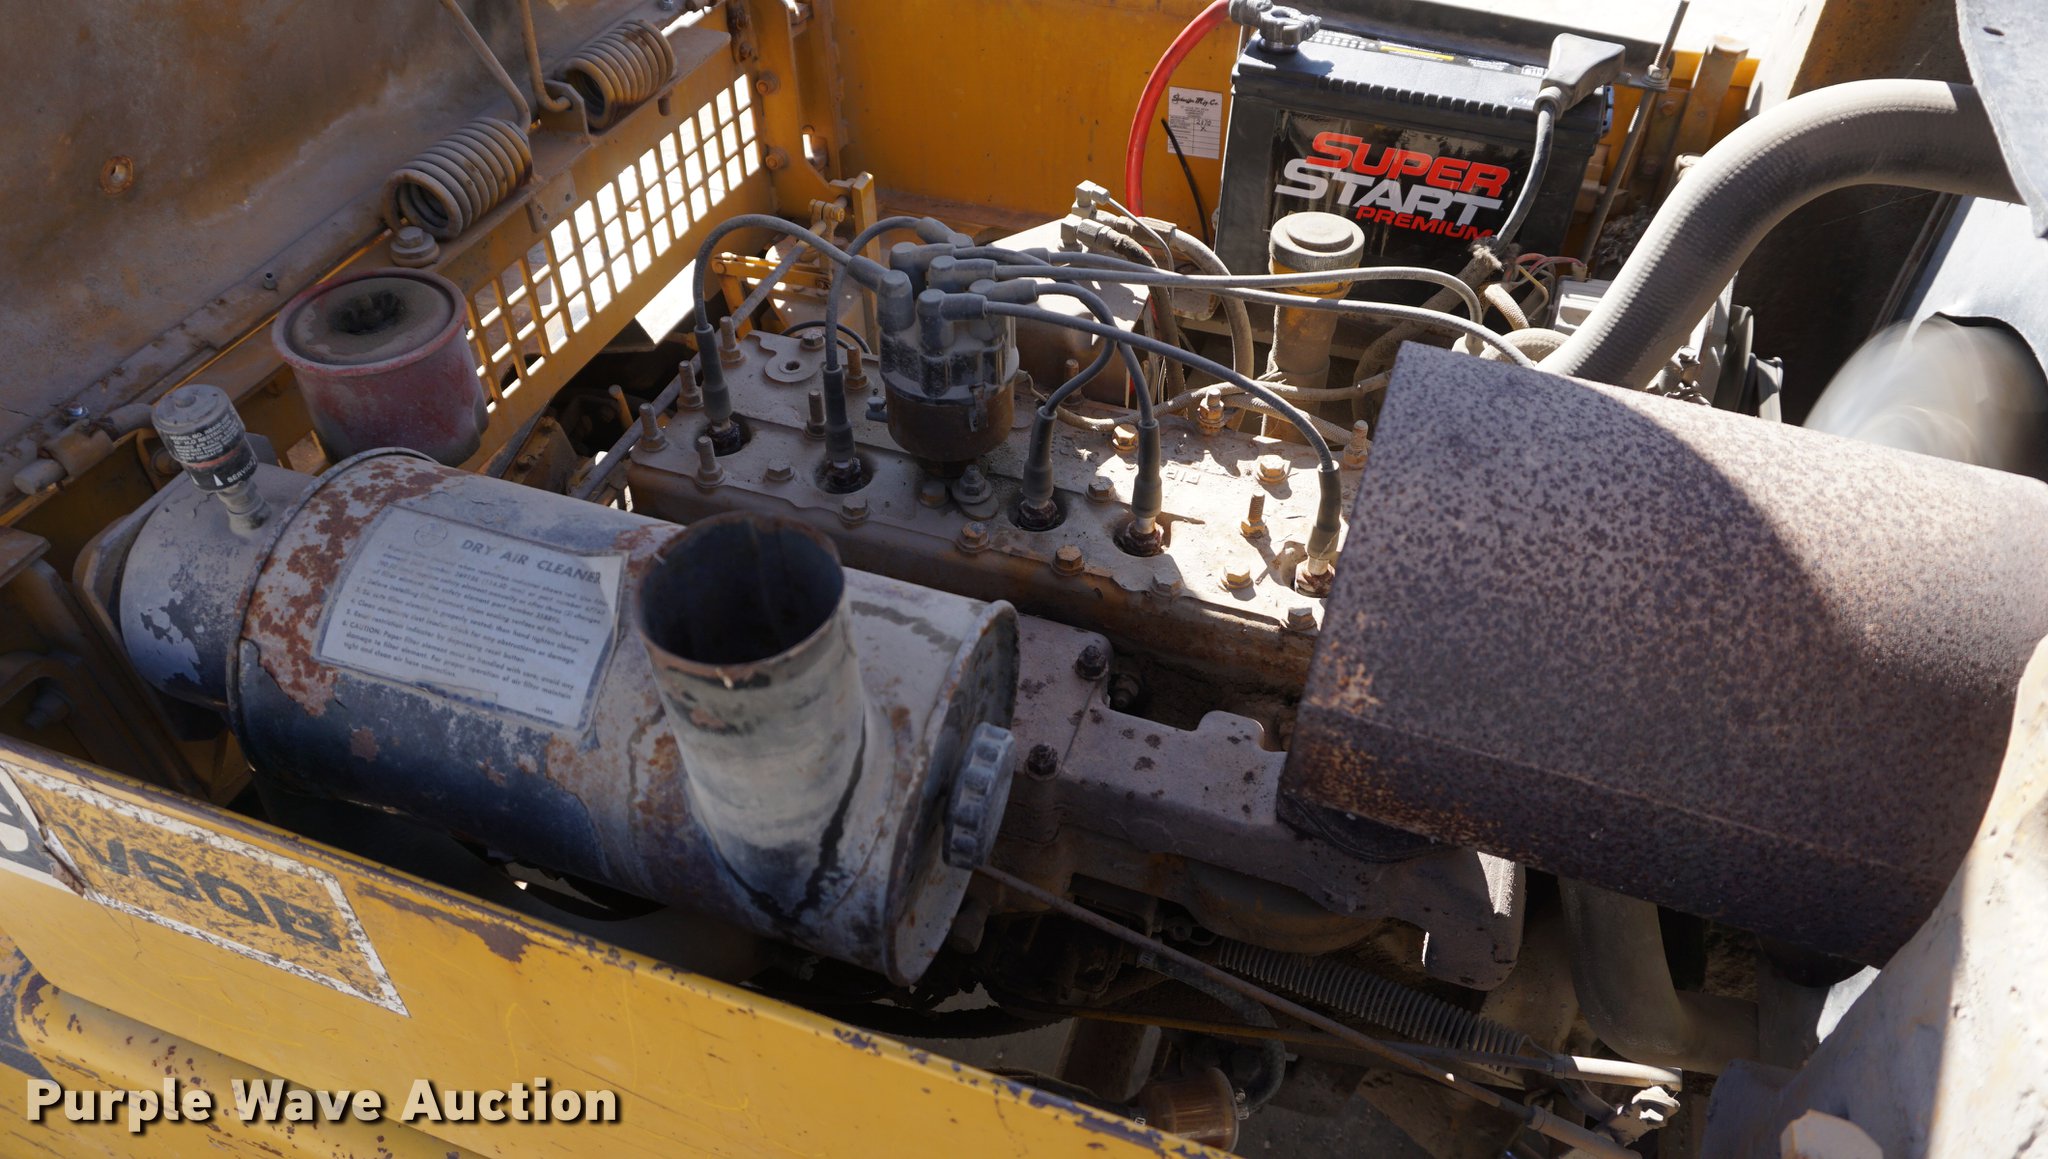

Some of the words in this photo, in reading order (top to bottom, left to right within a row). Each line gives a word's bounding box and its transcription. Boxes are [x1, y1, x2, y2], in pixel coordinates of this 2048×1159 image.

[1306, 131, 1511, 198] SUPER
[1274, 158, 1503, 226] START
[1355, 205, 1497, 241] PREMIUM
[227, 457, 254, 482] SERVICE
[462, 539, 496, 556] DRY
[500, 549, 528, 564] AIR
[537, 560, 601, 584] CLEANER
